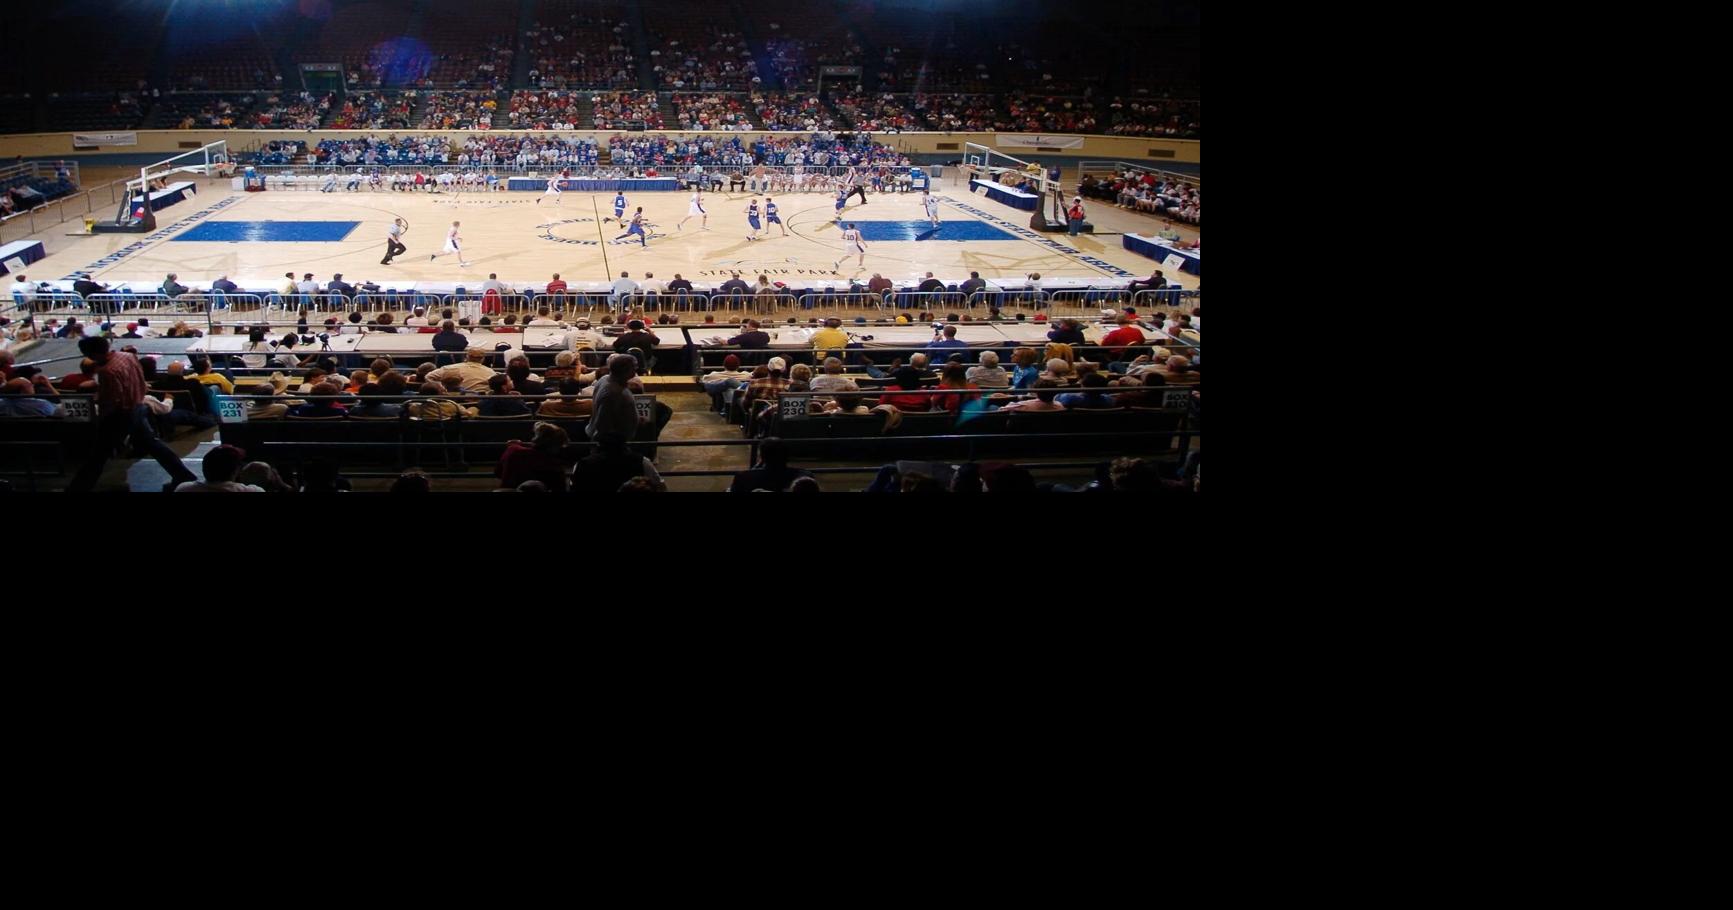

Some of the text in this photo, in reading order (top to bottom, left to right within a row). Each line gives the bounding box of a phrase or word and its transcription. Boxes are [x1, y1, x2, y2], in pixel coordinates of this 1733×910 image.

[1036, 239, 1081, 254] FAIR
[1079, 256, 1135, 277] AREN
[699, 268, 746, 276] STATE
[797, 268, 841, 276] PARK
[784, 400, 806, 408] BOX
